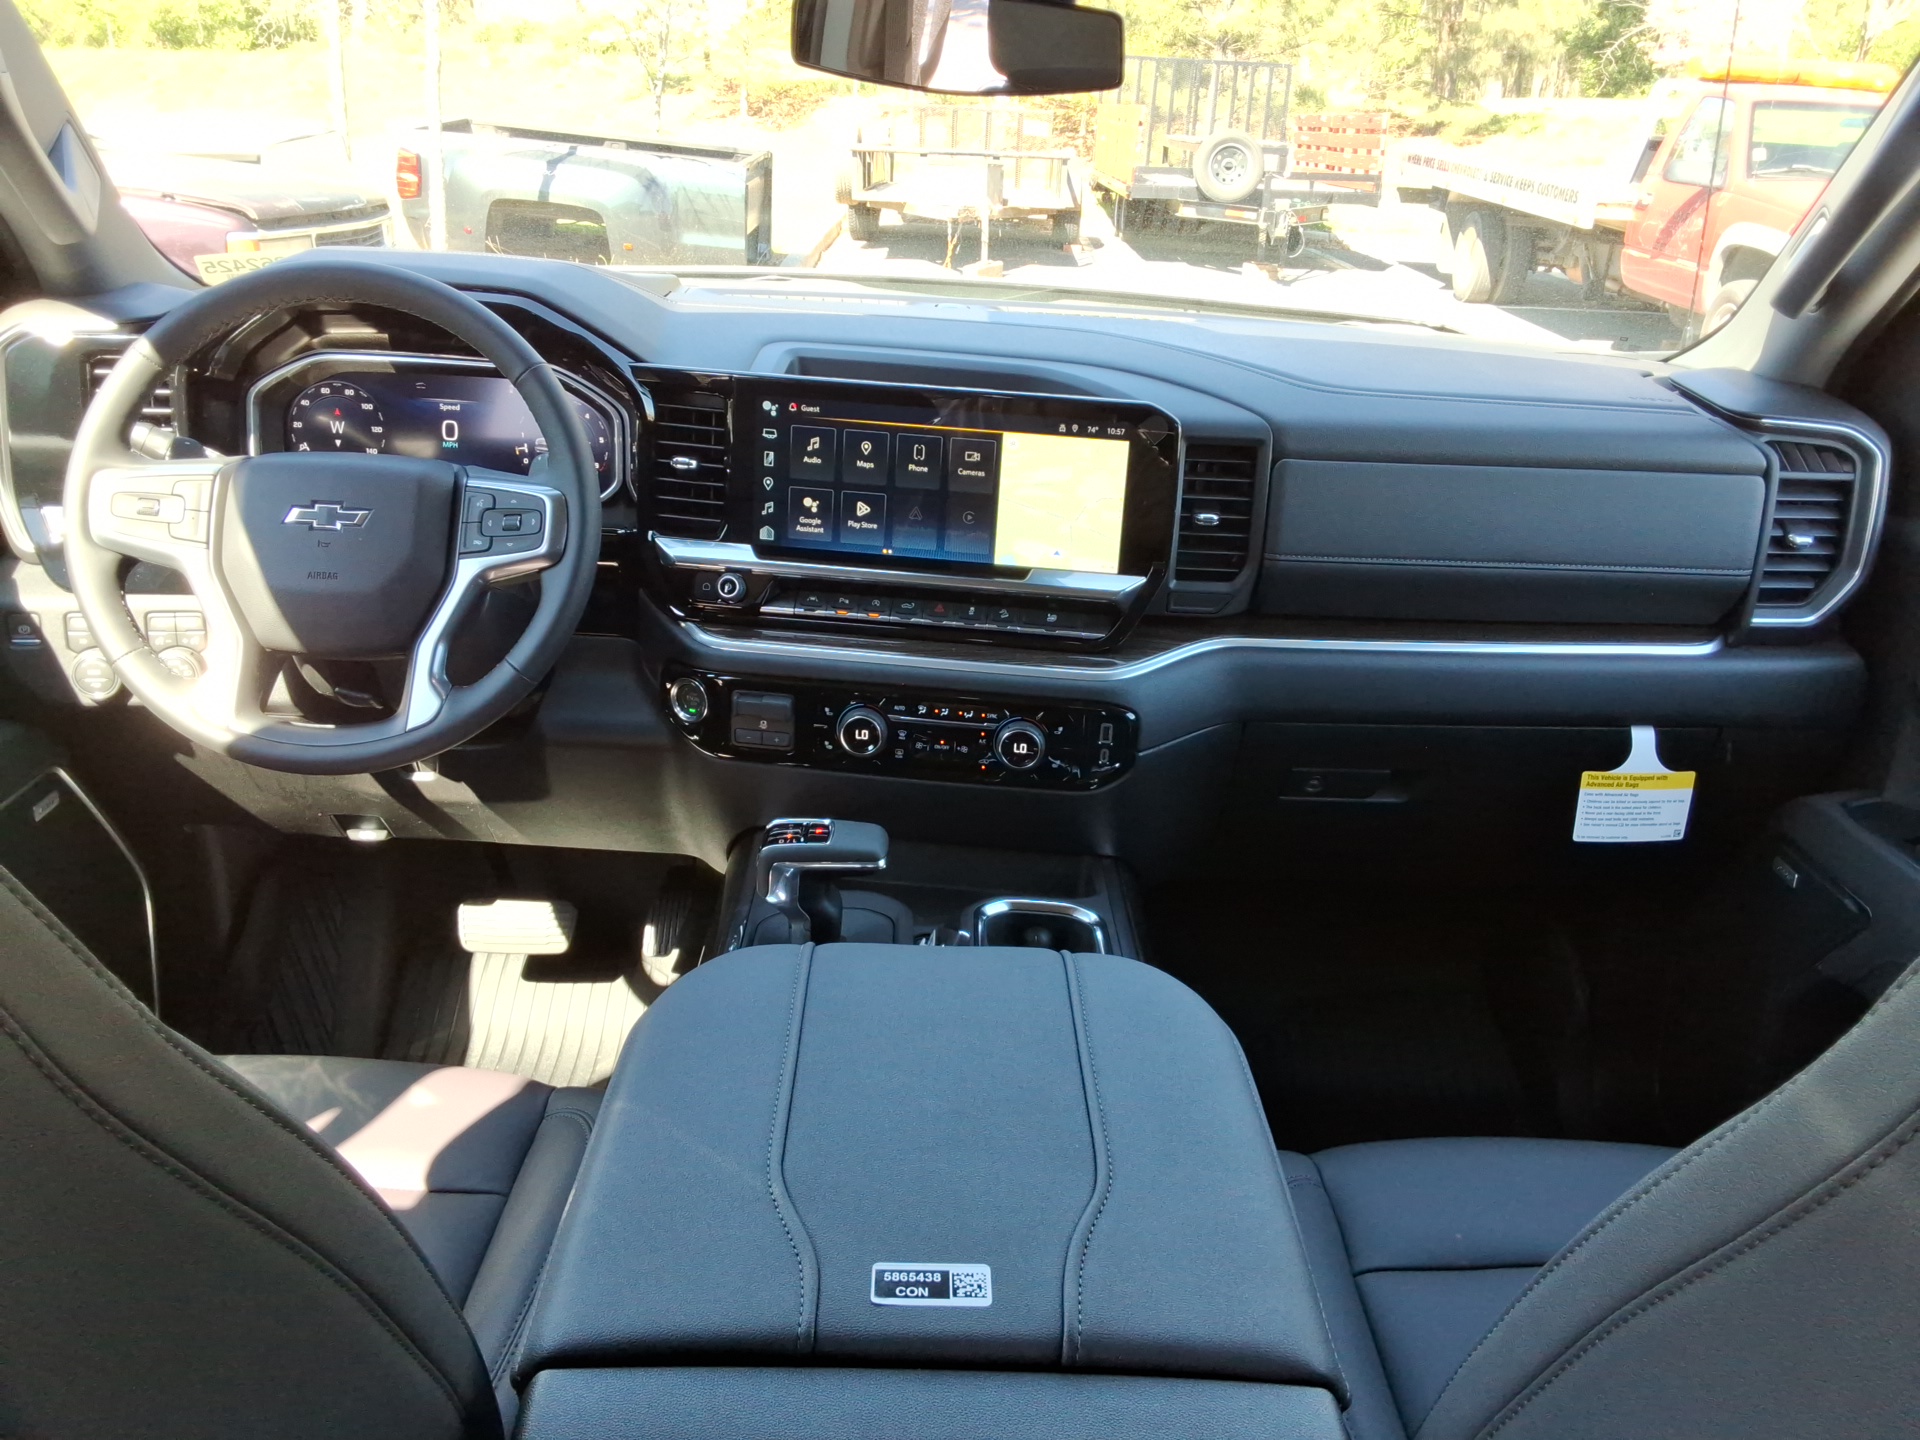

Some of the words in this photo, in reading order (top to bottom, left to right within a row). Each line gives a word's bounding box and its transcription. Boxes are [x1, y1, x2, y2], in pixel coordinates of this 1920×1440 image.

[1490, 171, 1514, 187] SERVICE
[1514, 178, 1536, 193] KEEPS
[1537, 182, 1579, 204] CUSTOMERS
[439, 403, 461, 412] Speed
[800, 404, 821, 413] Guest
[330, 420, 345, 434] W
[441, 419, 459, 441] 0
[1087, 425, 1099, 434] 74°
[1107, 427, 1126, 436] 10:57
[442, 441, 459, 449] MPH
[365, 447, 378, 455] 140
[803, 456, 822, 465] Audio
[856, 460, 875, 470] Maps
[908, 464, 929, 473] Phone
[957, 467, 986, 478] Cameras
[799, 516, 822, 526] Google
[847, 520, 861, 530] Play
[861, 521, 878, 530] Store
[796, 524, 824, 534] Assistant
[307, 571, 339, 580] AIRBAG
[855, 729, 869, 740] LO
[1013, 742, 1028, 754] LO
[1629, 774, 1655, 782] Equipped
[1625, 781, 1640, 789] Bags
[883, 1271, 942, 1283] 5865438
[895, 1286, 929, 1297] CON
